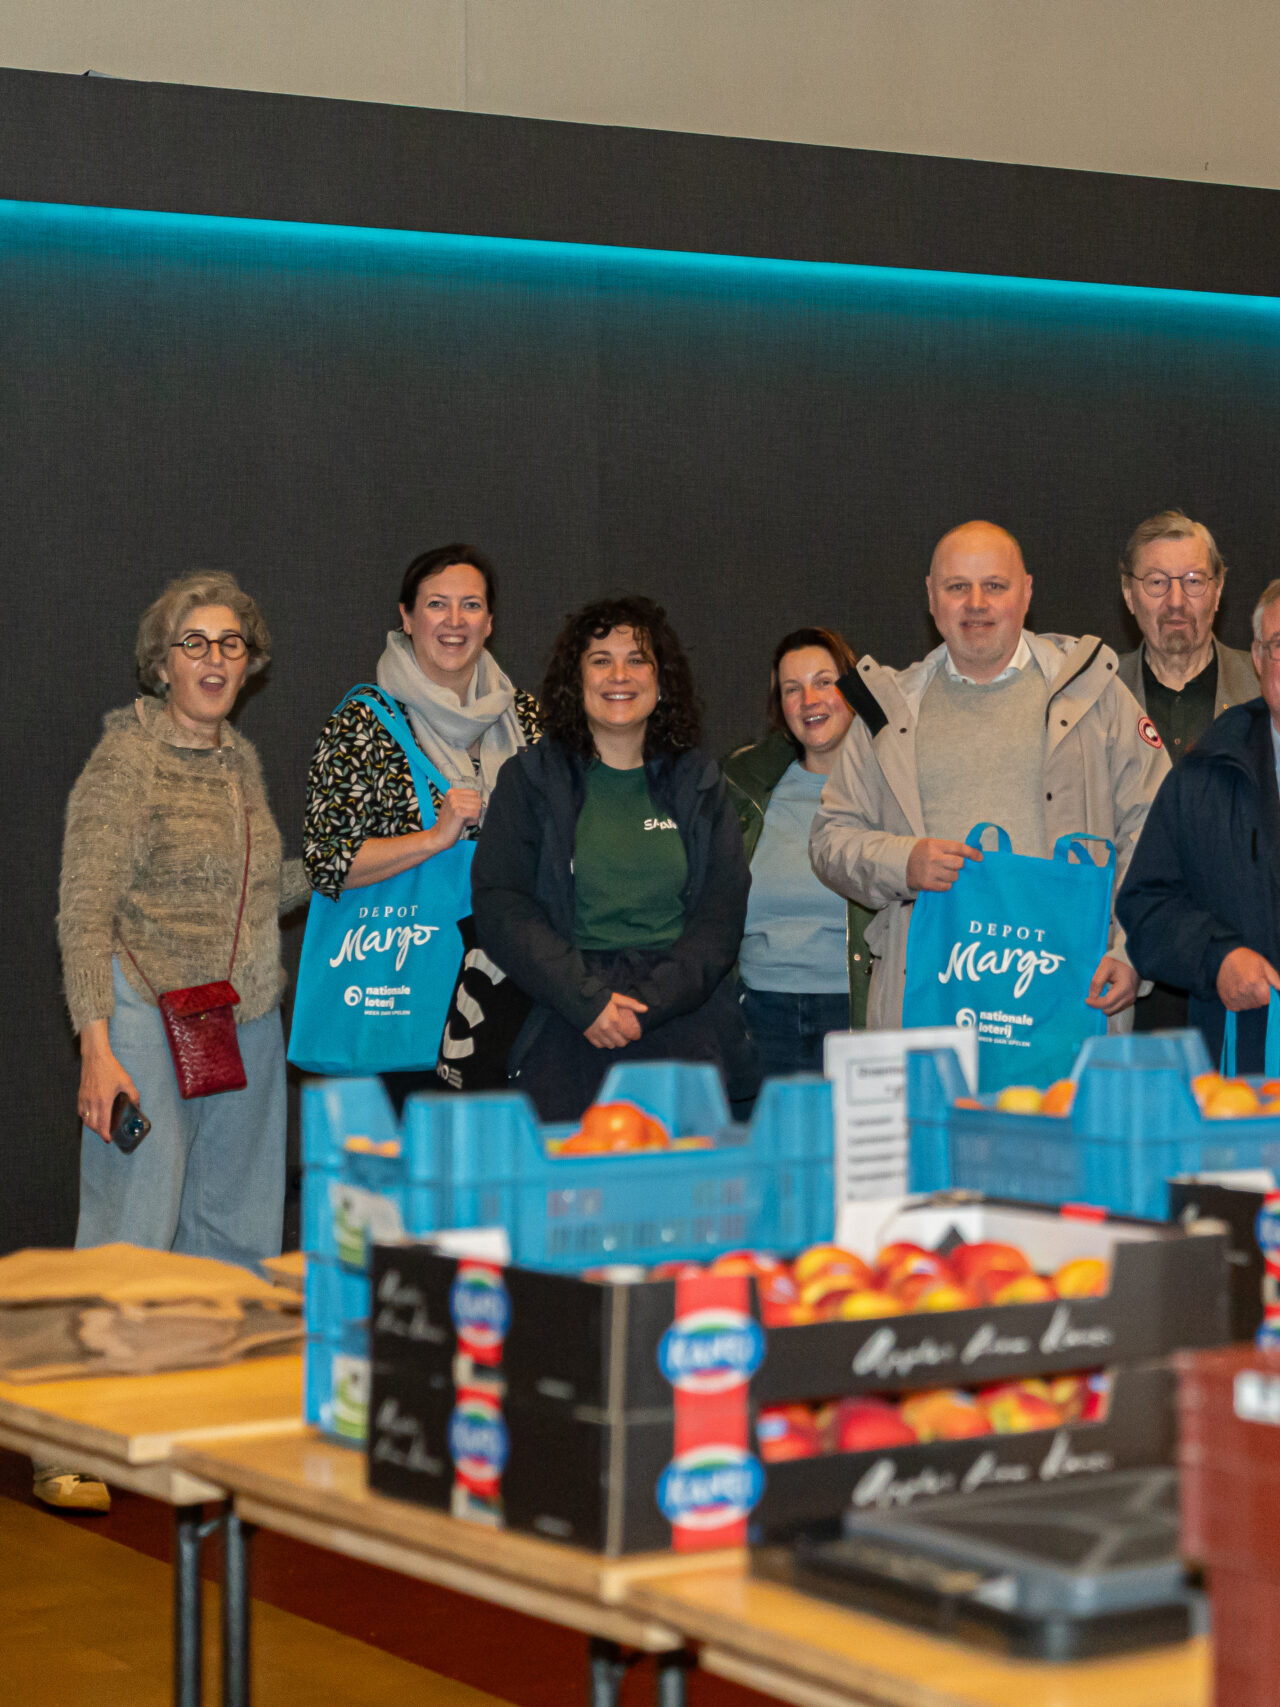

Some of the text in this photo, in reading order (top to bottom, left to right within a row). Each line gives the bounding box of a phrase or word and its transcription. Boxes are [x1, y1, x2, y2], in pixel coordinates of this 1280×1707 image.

[359, 905, 419, 919] DEPOT
[969, 920, 1046, 942] DEPOT
[329, 924, 440, 972] Margo
[938, 941, 1066, 999] Margo
[979, 1010, 1033, 1026] nationale
[978, 1022, 1013, 1038] loterij
